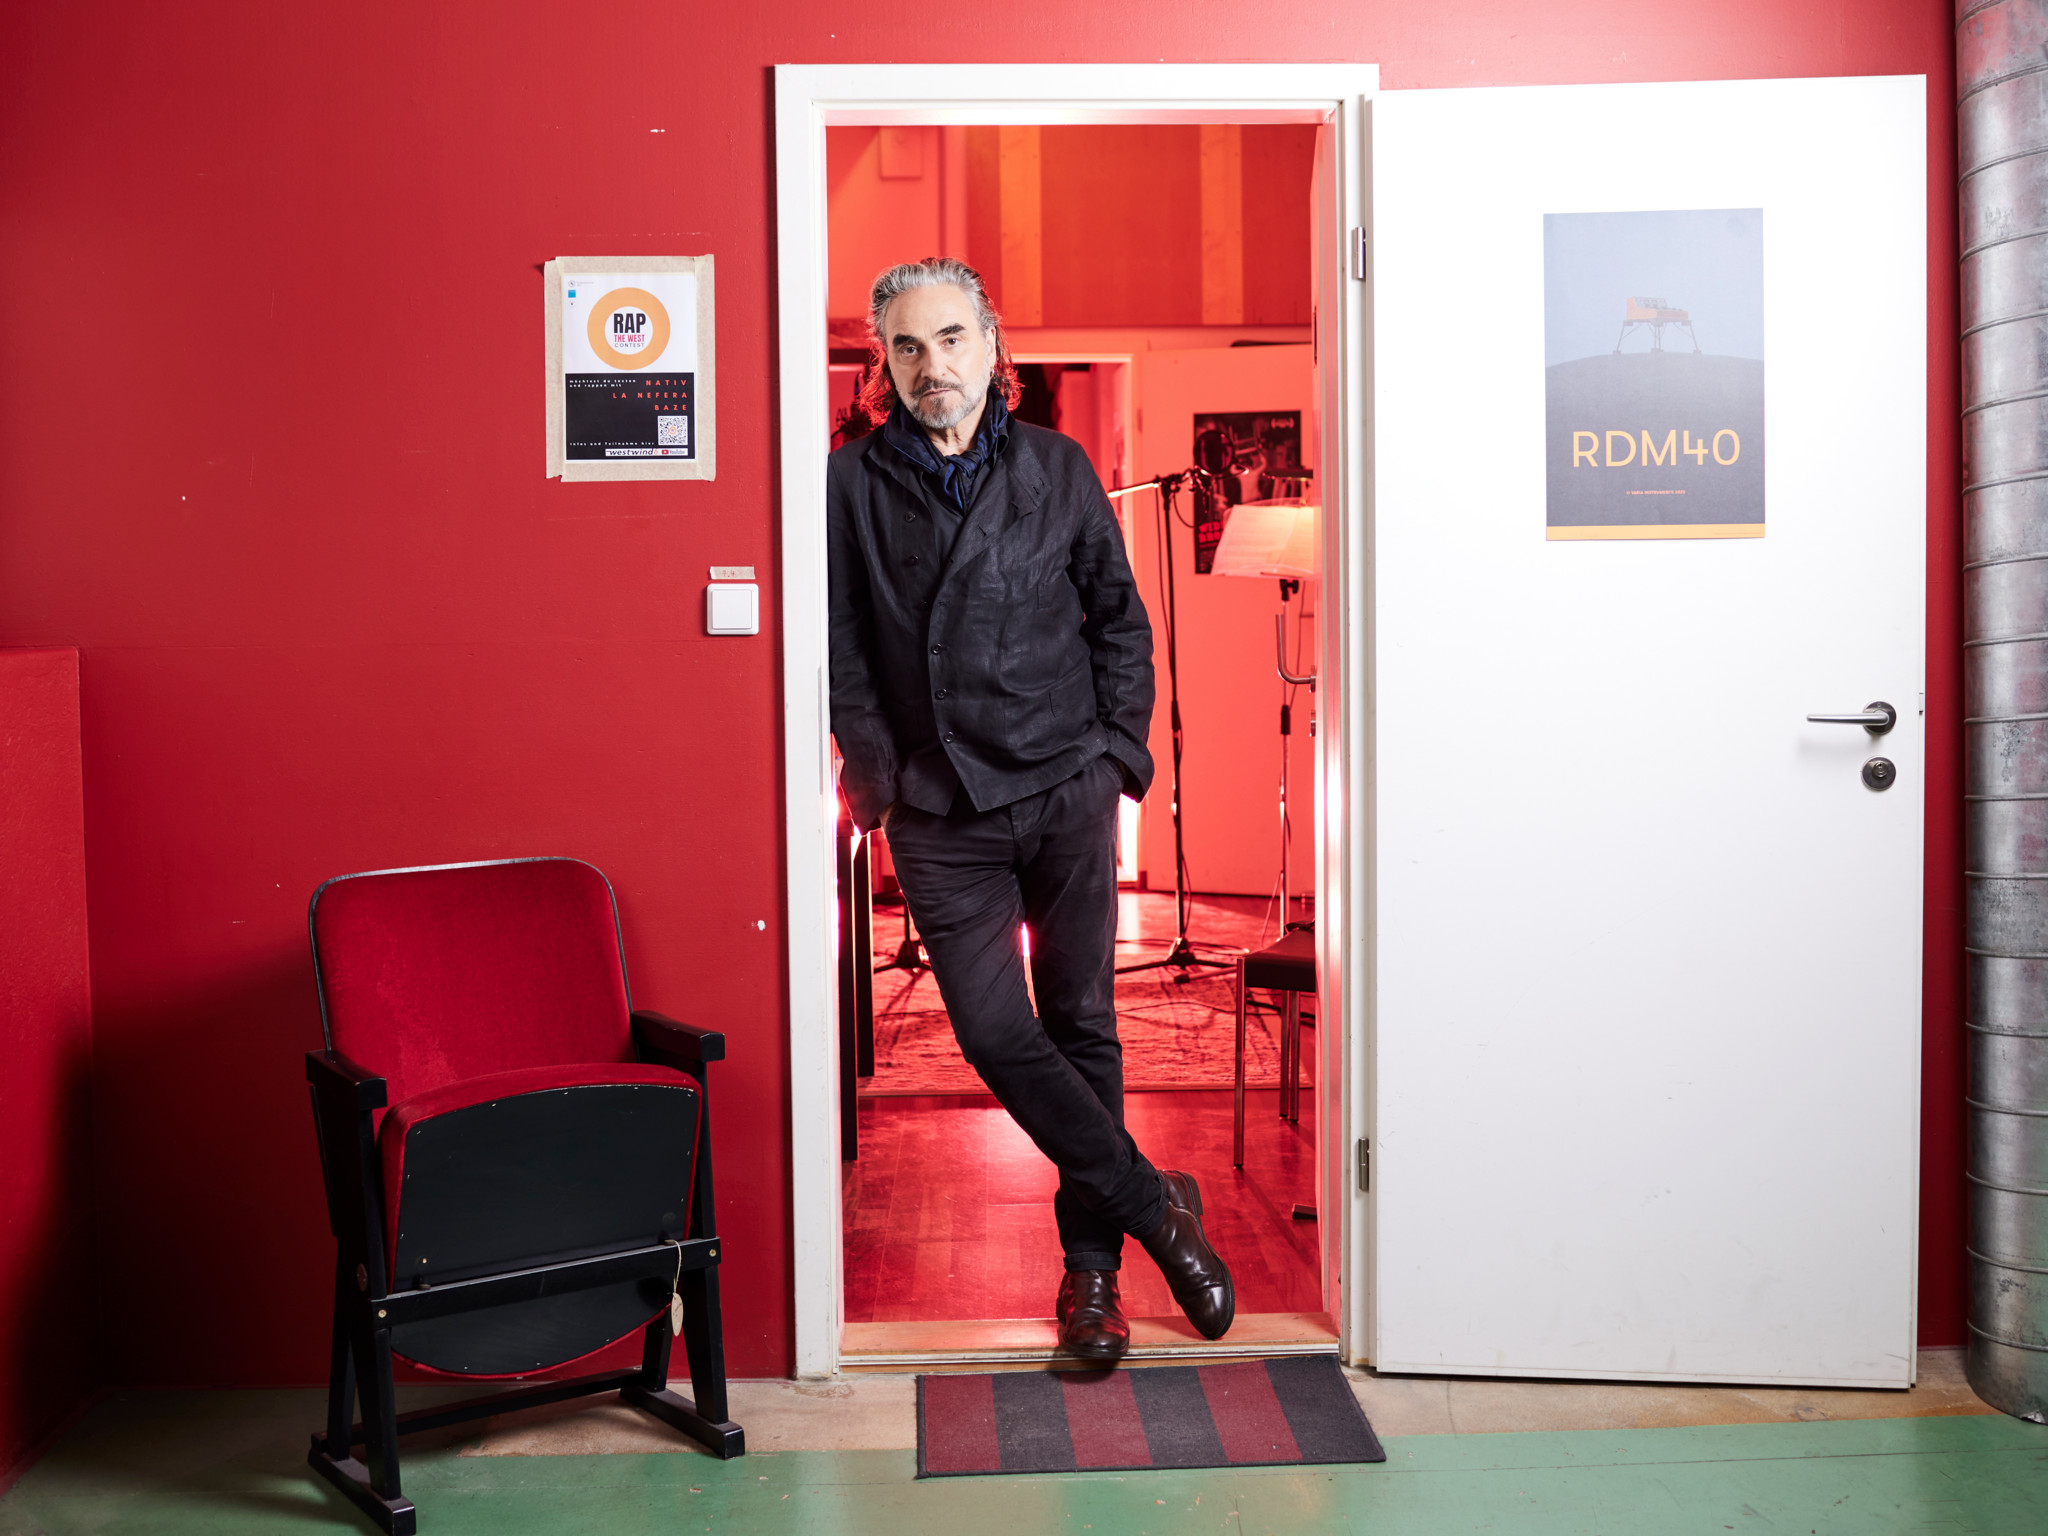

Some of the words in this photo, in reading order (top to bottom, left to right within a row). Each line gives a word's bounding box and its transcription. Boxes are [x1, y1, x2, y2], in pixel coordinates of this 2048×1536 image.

[613, 313, 646, 333] RAP
[614, 334, 625, 342] THE
[627, 334, 645, 342] WEST
[607, 448, 653, 456] westwind
[1573, 429, 1740, 467] RDM40
